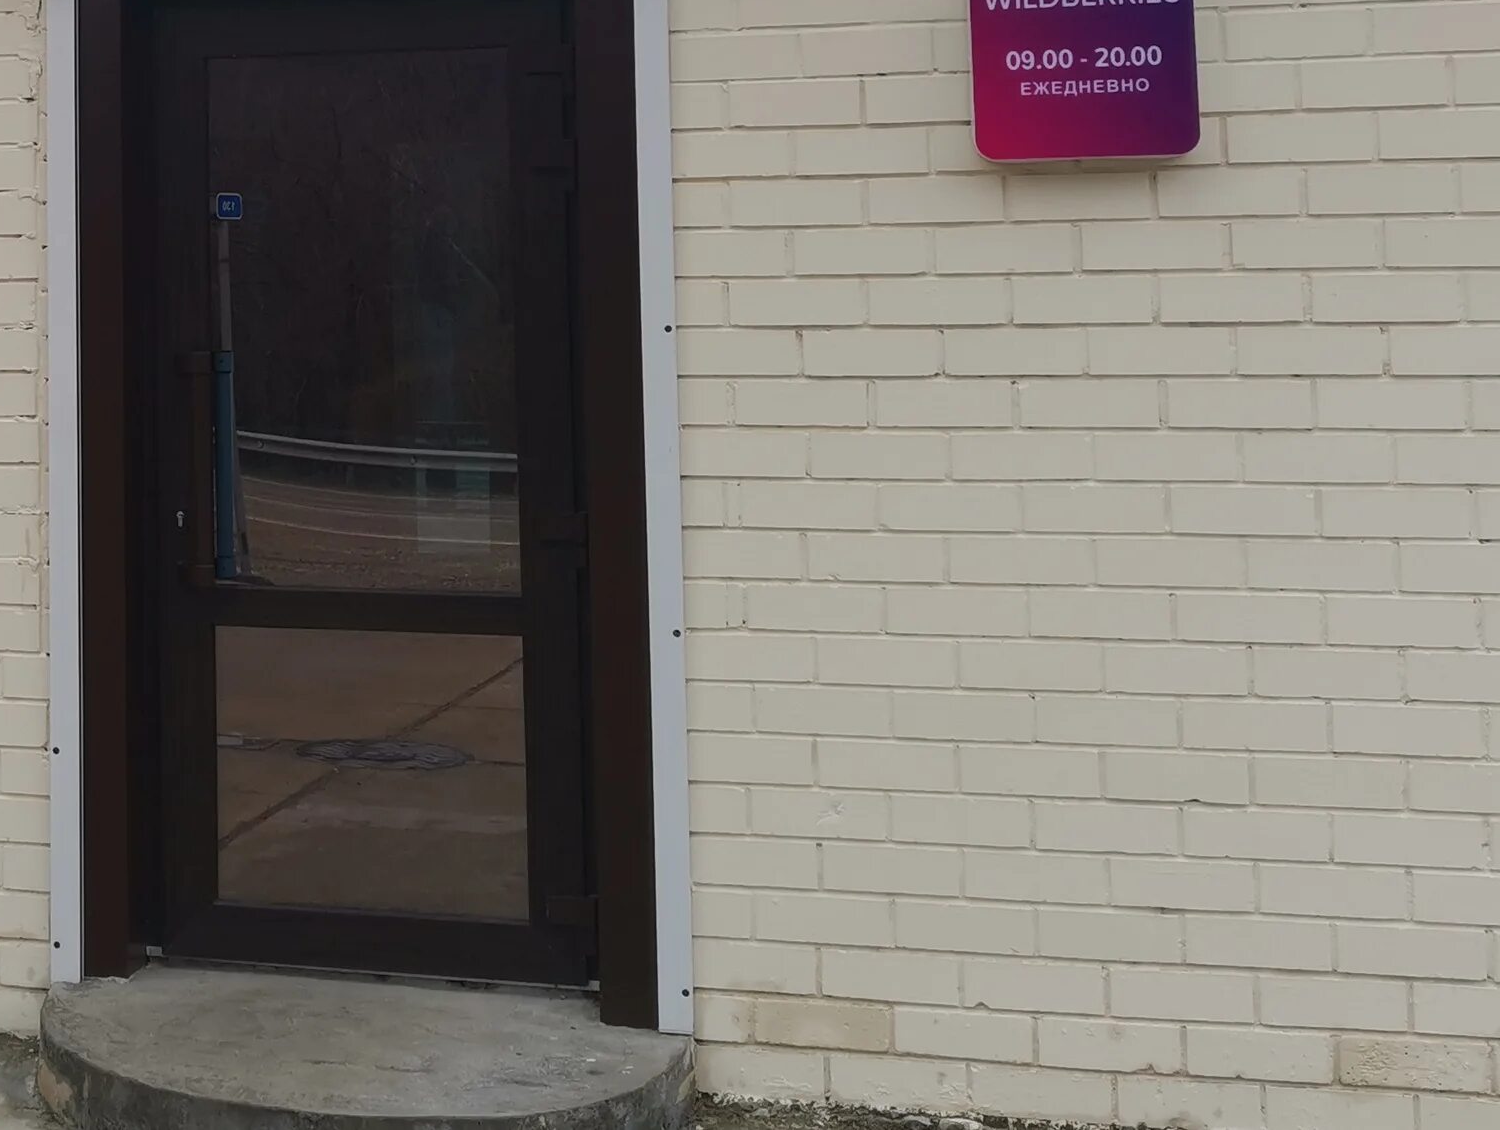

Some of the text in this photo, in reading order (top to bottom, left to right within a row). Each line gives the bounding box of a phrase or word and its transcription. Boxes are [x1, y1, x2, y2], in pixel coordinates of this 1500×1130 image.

[1005, 48, 1073, 71] 09.00
[1094, 45, 1162, 68] 20.00
[1020, 78, 1150, 96] ЕЖЕДНЕВНО
